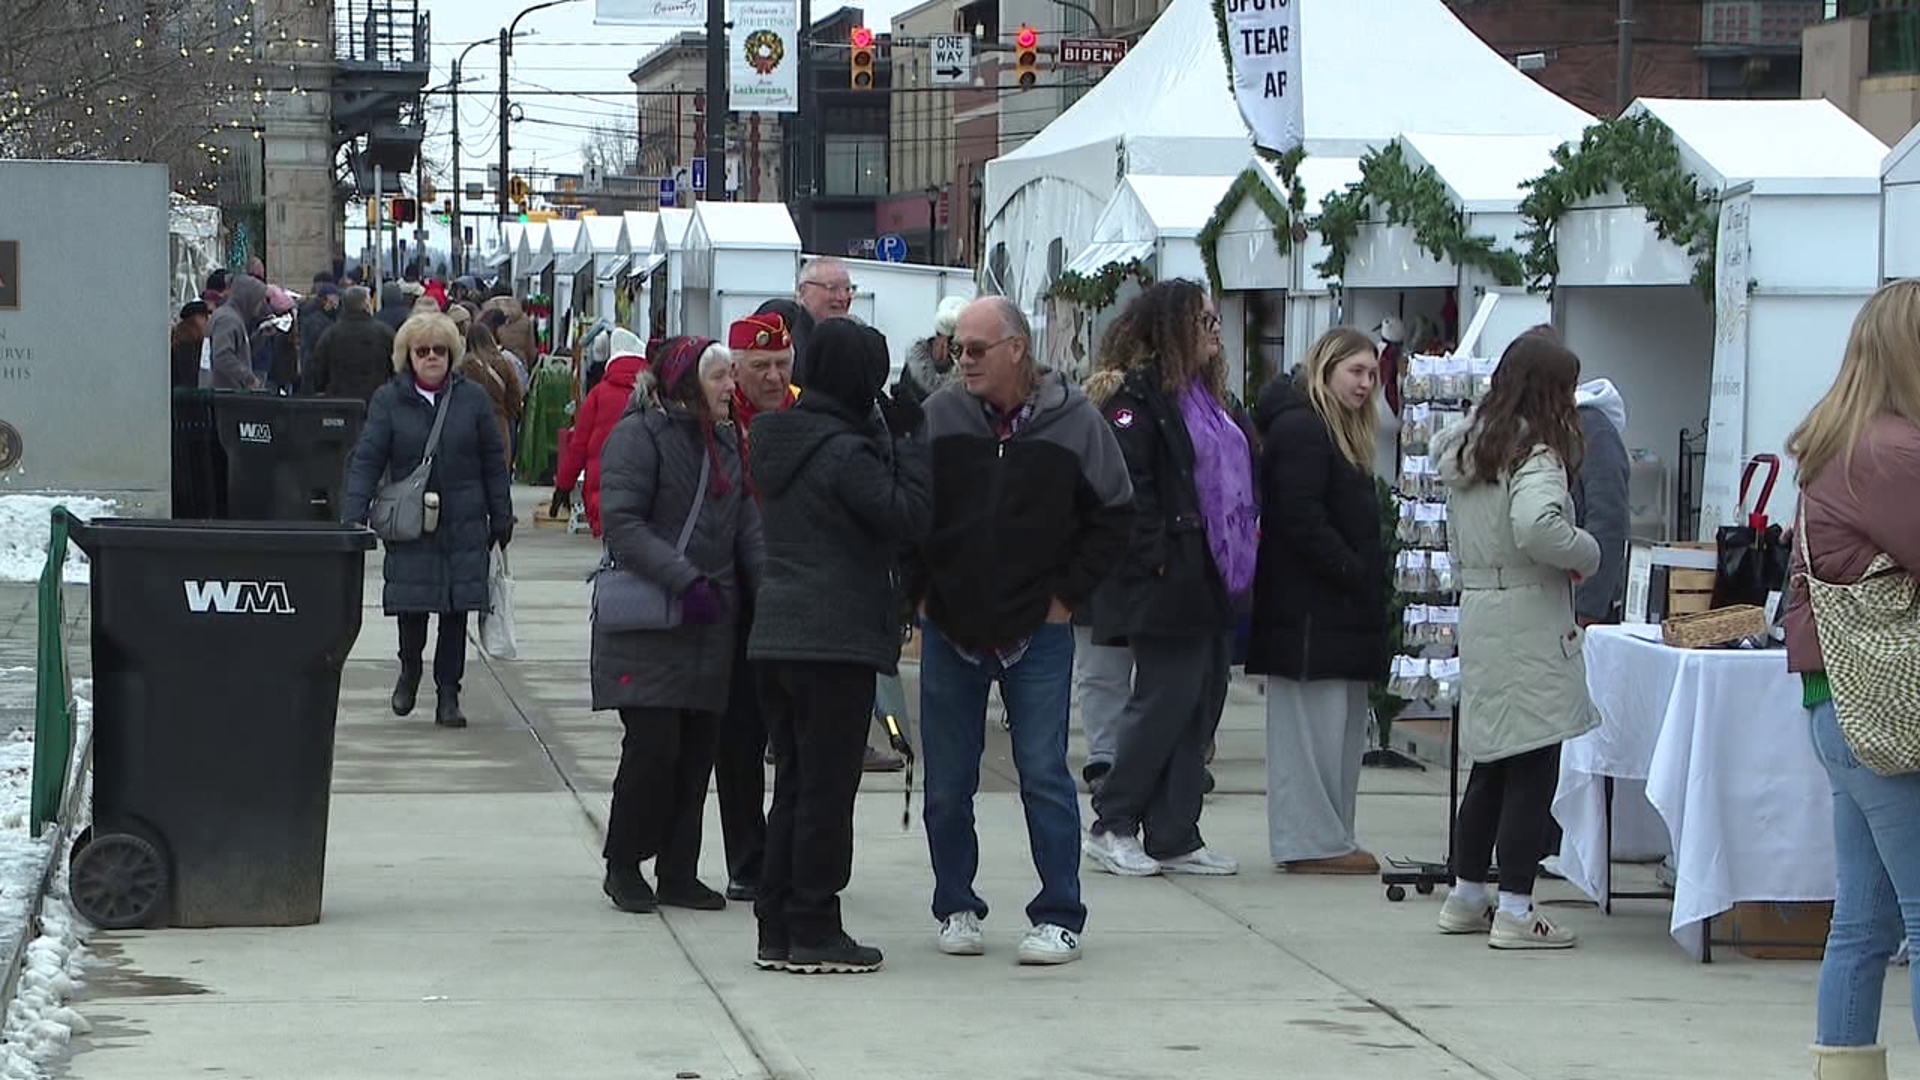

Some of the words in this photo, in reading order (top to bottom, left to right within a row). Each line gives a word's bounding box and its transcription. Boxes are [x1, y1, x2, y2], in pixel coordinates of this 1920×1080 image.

[937, 35, 963, 49] ONE
[935, 50, 964, 63] WAY
[1064, 47, 1113, 62] BIDEN
